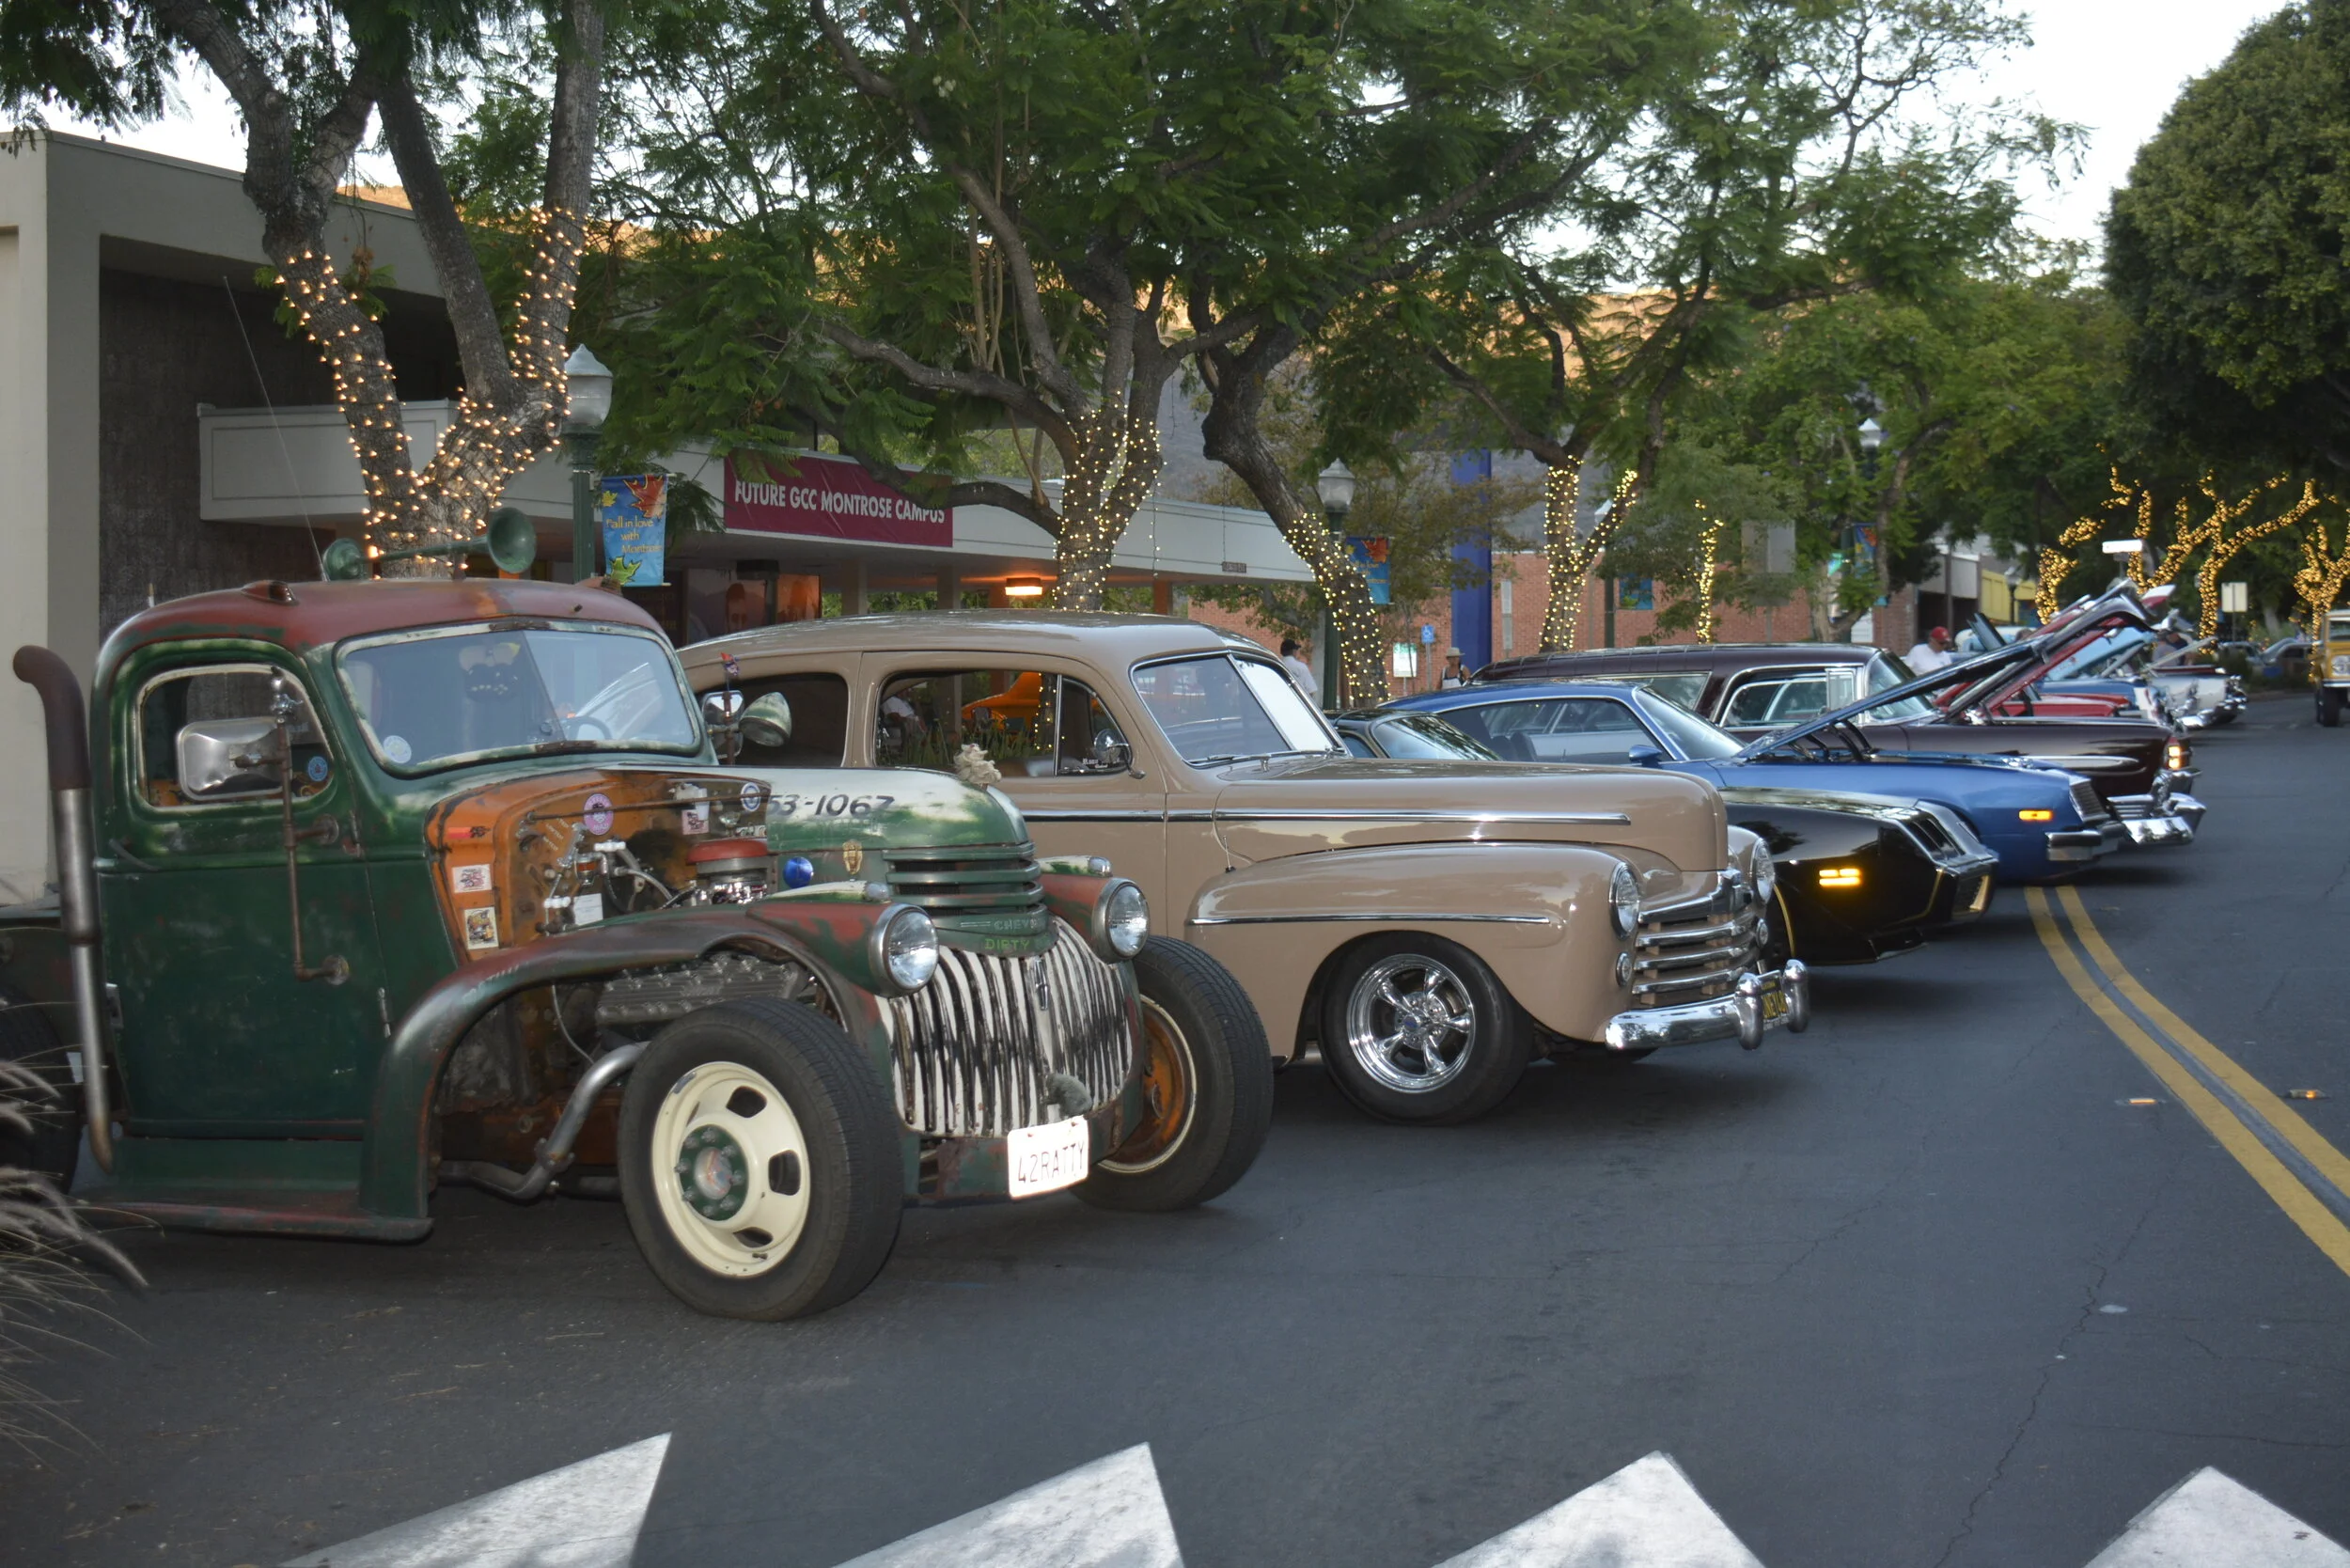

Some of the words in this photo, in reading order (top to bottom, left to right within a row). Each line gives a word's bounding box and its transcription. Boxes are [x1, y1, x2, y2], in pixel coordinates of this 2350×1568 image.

[734, 480, 786, 507] FUTURE
[790, 486, 817, 511] GCC
[821, 490, 892, 518] MONTROSE
[895, 498, 945, 524] CAMPUS
[606, 516, 623, 528] Fall
[621, 528, 639, 541] with
[1018, 1141, 1086, 1184] 42RATTY
